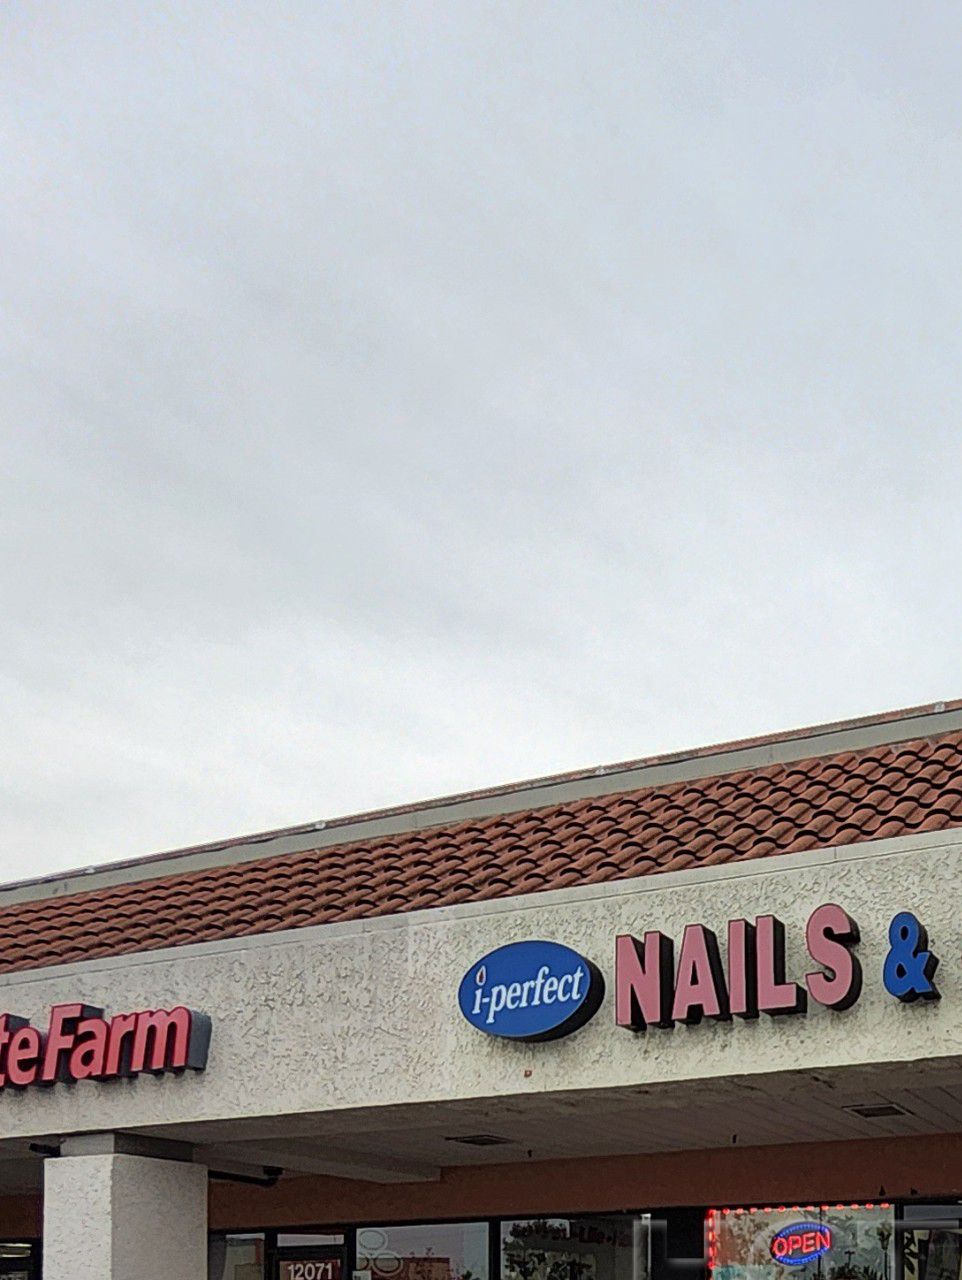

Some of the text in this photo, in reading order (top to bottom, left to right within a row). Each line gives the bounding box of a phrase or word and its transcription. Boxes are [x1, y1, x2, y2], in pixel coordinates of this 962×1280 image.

[471, 966, 584, 1024] i-perfect
[615, 903, 860, 1030] NAILS
[883, 911, 938, 999] &
[773, 1232, 832, 1258] OPEN
[288, 1263, 333, 1280] 12071
